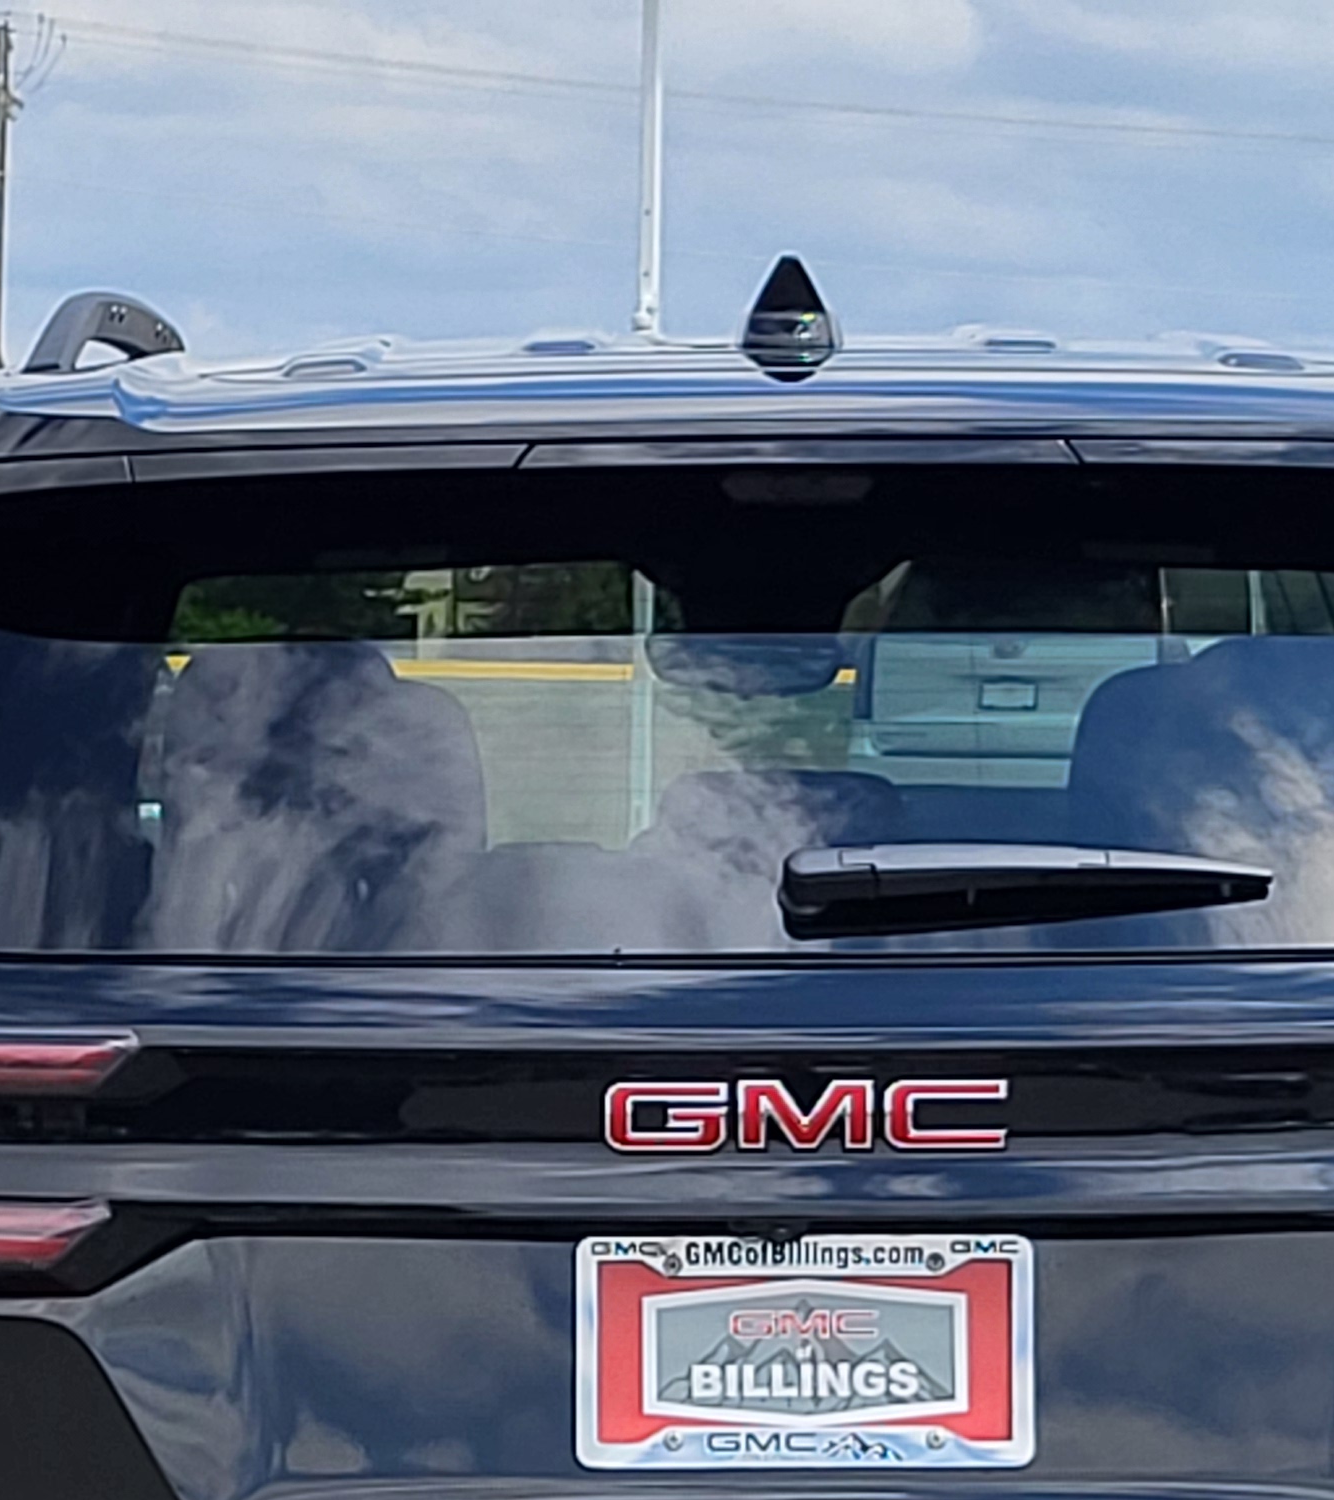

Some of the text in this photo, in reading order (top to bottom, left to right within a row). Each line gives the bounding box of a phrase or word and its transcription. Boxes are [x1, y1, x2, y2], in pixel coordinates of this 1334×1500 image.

[604, 1079, 1008, 1151] GMC
[949, 1239, 1019, 1254] GMC
[729, 1309, 879, 1340] GMC
[691, 1361, 920, 1399] BILLINGS
[706, 1432, 817, 1455] GMC
